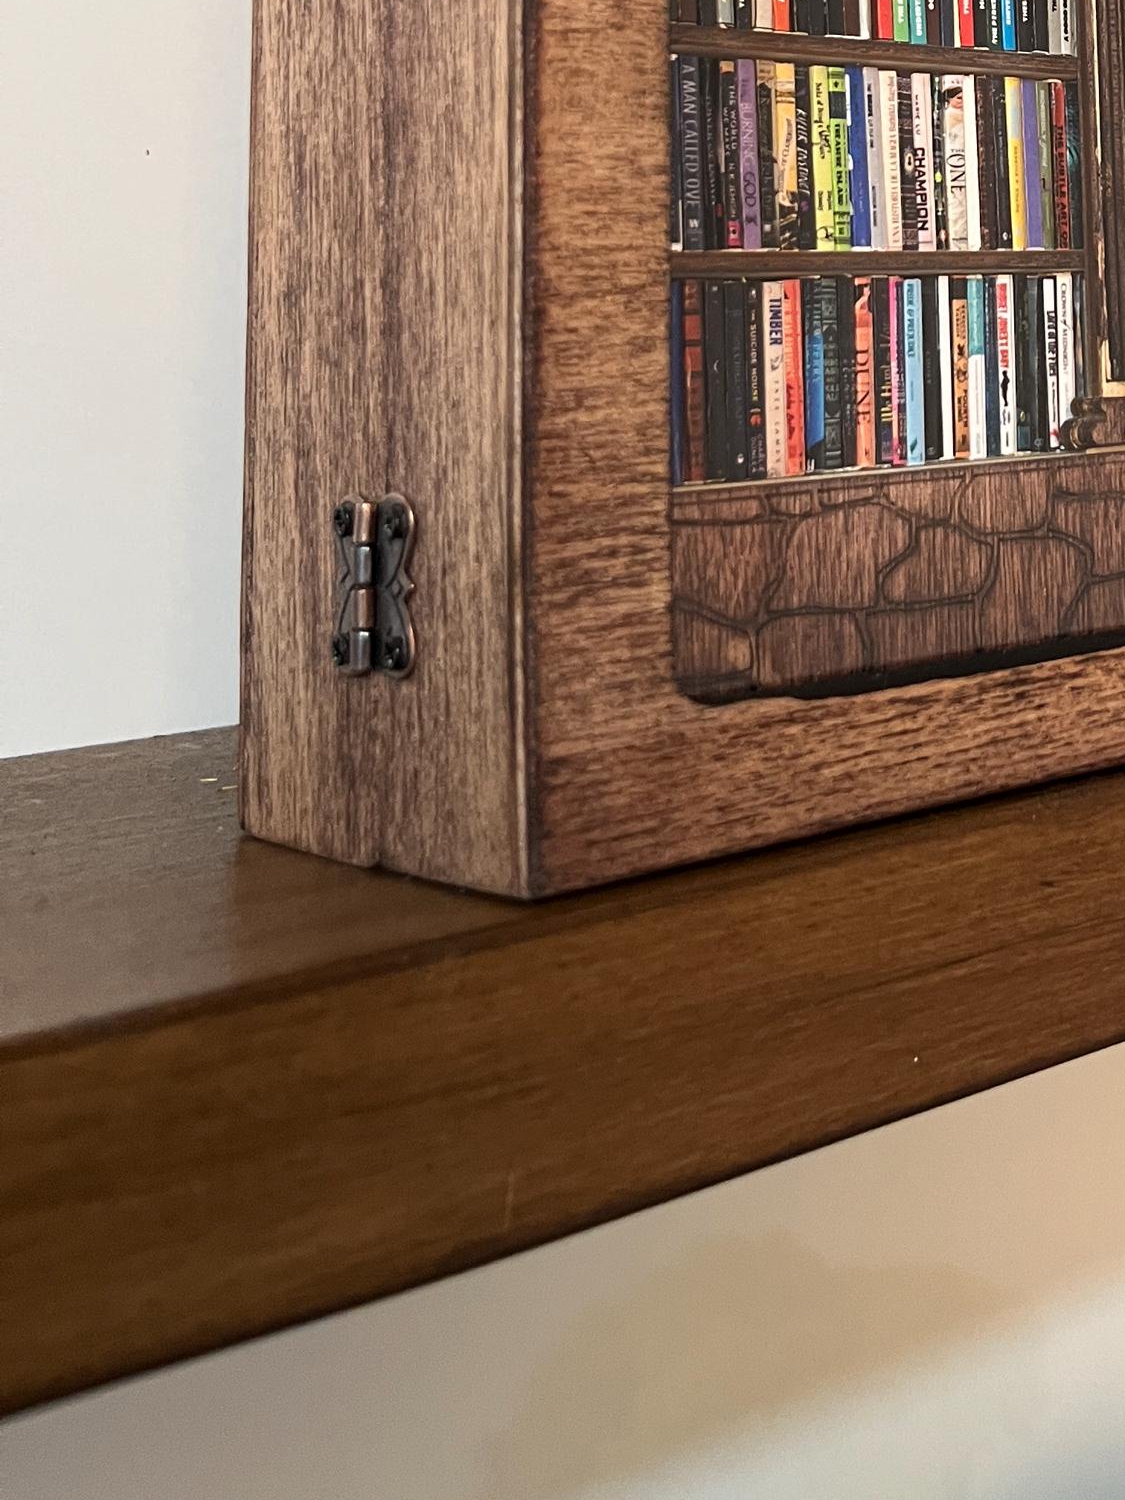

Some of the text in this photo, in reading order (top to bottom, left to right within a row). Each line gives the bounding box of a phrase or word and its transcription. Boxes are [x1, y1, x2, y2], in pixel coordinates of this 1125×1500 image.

[682, 64, 700, 210] A MAN CALLED OVE
[729, 84, 738, 150] THE WORLD
[915, 124, 921, 135] LU
[1056, 125, 1064, 148] THE
[740, 102, 756, 207] BURNING GOD
[796, 108, 810, 196] KILLER INSTINCT
[834, 123, 844, 206] TREASURE ISLAND
[947, 154, 966, 194] ONE
[1057, 152, 1066, 197] SUBTLE
[914, 147, 929, 231] CHAMPION
[1059, 202, 1067, 228] ART
[750, 324, 758, 364] SUICIDE
[770, 299, 782, 346] TIMBER
[906, 283, 915, 358] PRIDE & PREJUDICE
[855, 348, 870, 425] DUNE
